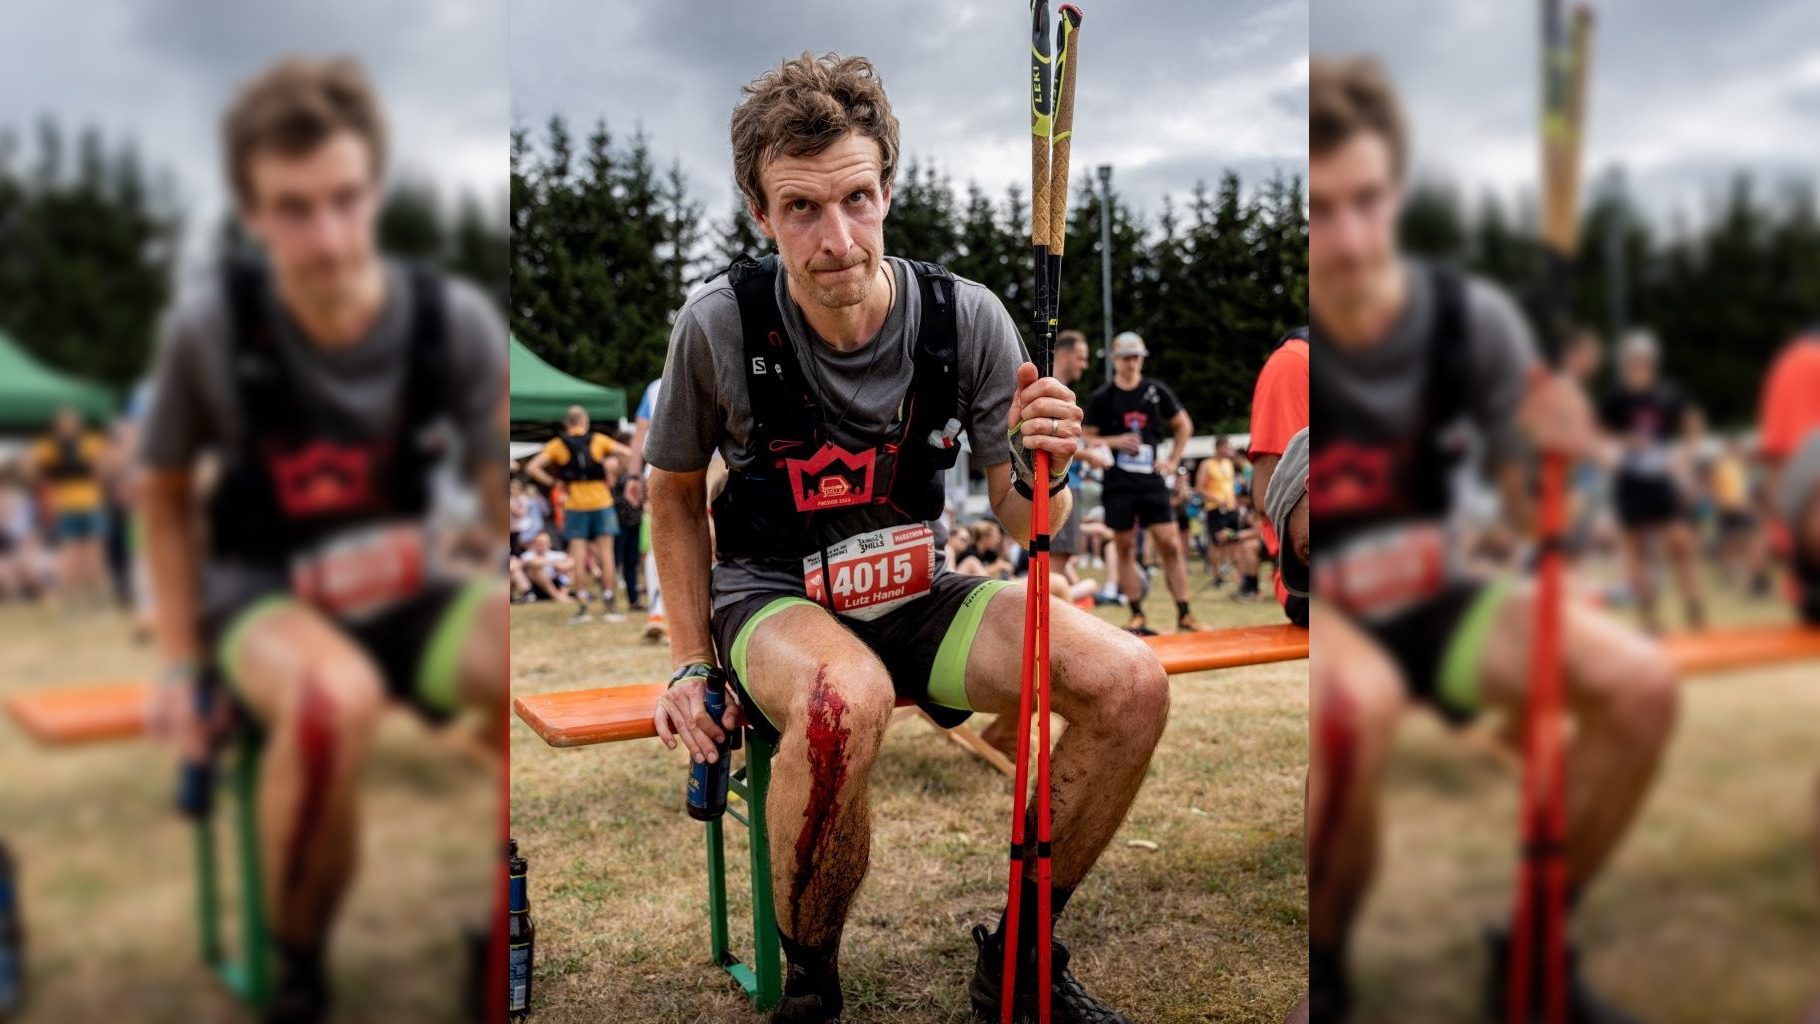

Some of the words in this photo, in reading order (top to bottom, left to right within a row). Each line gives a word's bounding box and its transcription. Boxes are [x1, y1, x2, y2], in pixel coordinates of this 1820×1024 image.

[1032, 66, 1043, 103] LEKI
[894, 528, 923, 542] MARATHON
[860, 540, 885, 554] 3HILLS
[832, 553, 912, 597] 4015
[845, 595, 870, 608] Lutz
[872, 586, 905, 602] Hanel
